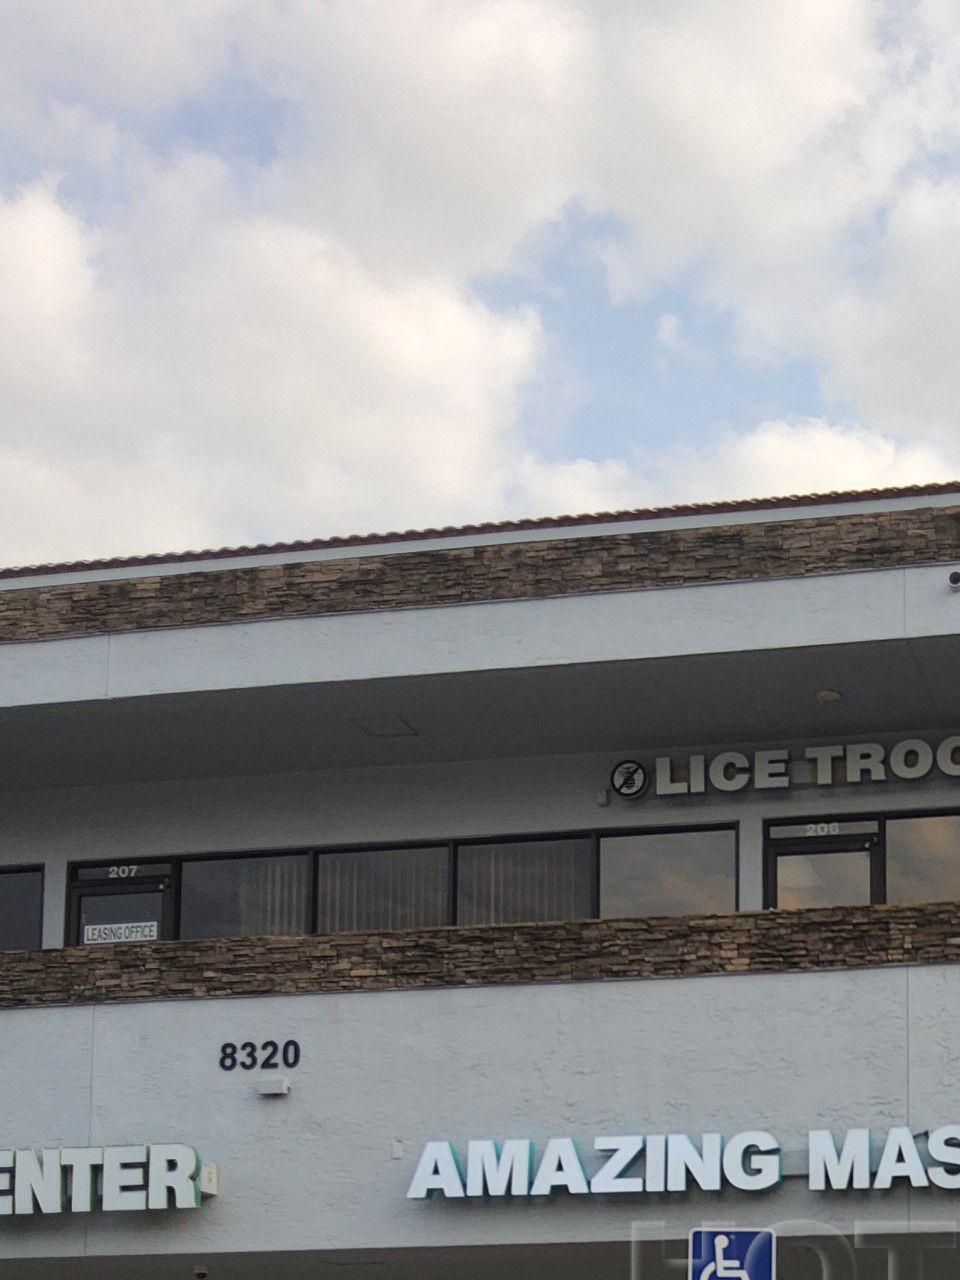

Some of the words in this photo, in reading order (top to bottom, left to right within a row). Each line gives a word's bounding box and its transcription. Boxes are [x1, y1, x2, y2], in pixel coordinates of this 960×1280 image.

[655, 750, 790, 795] LICE
[806, 822, 840, 836] 206
[109, 866, 138, 878] 207
[86, 927, 122, 942] LEASING
[124, 924, 155, 940] OFFICE
[219, 1039, 300, 1071] 8320
[406, 1130, 782, 1199] AMAZING
